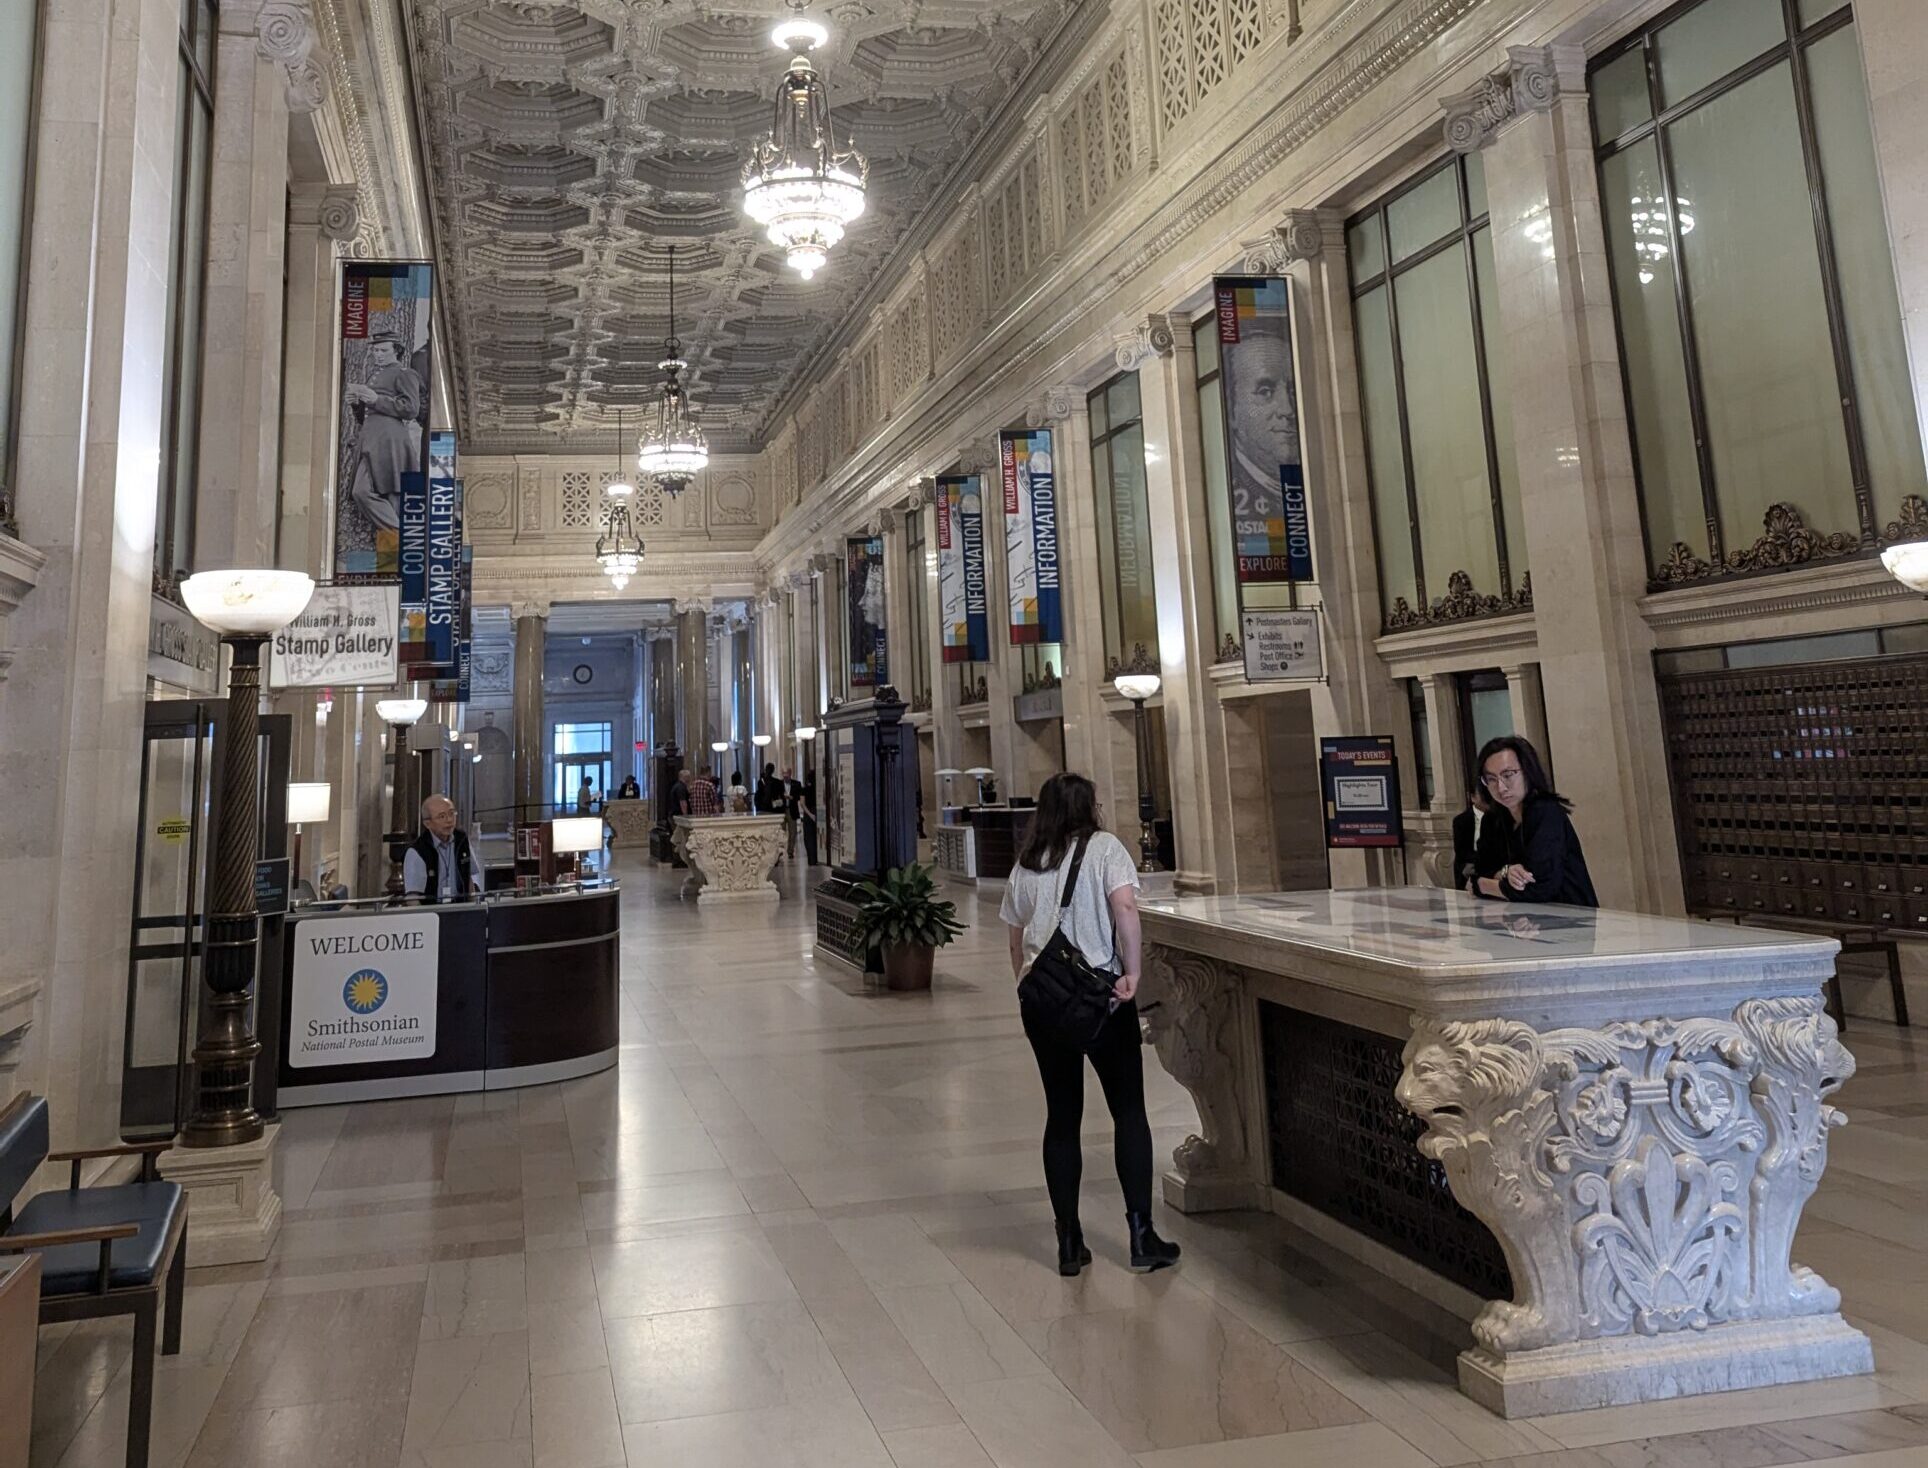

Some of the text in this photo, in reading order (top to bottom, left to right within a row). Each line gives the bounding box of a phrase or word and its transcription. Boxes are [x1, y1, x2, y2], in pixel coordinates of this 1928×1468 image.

[346, 281, 364, 335] IMAGINE
[1218, 292, 1237, 341] IMAGINE
[1002, 440, 1014, 466] GROSS
[938, 484, 947, 508] GROSS
[1004, 476, 1016, 511] WILLIAM
[939, 517, 949, 546] WILLIAM
[1284, 482, 1308, 558] CONNECT
[402, 492, 426, 574] CONNECT
[1033, 478, 1059, 589] INFORMATION
[429, 483, 454, 625] STAMP GALLERY
[963, 517, 985, 615] INFORMATION
[1239, 557, 1288, 572] EXPLORE
[289, 613, 329, 629] William
[346, 613, 376, 628] Gross
[1292, 616, 1313, 628] Gallery
[275, 633, 394, 658] Stamp Gallery
[1258, 632, 1282, 641] Exhibits
[1259, 642, 1292, 651] Restrooms
[1260, 652, 1293, 661] Post Office
[1260, 662, 1279, 672] Shops
[458, 652, 470, 690] CONNECT
[1338, 751, 1386, 760] TODAY'S EVENTS
[159, 826, 189, 834] CAUTION
[310, 932, 424, 956] WELCOME
[307, 1014, 419, 1037] Smithsonian
[301, 1034, 425, 1053] National Postal Museum
